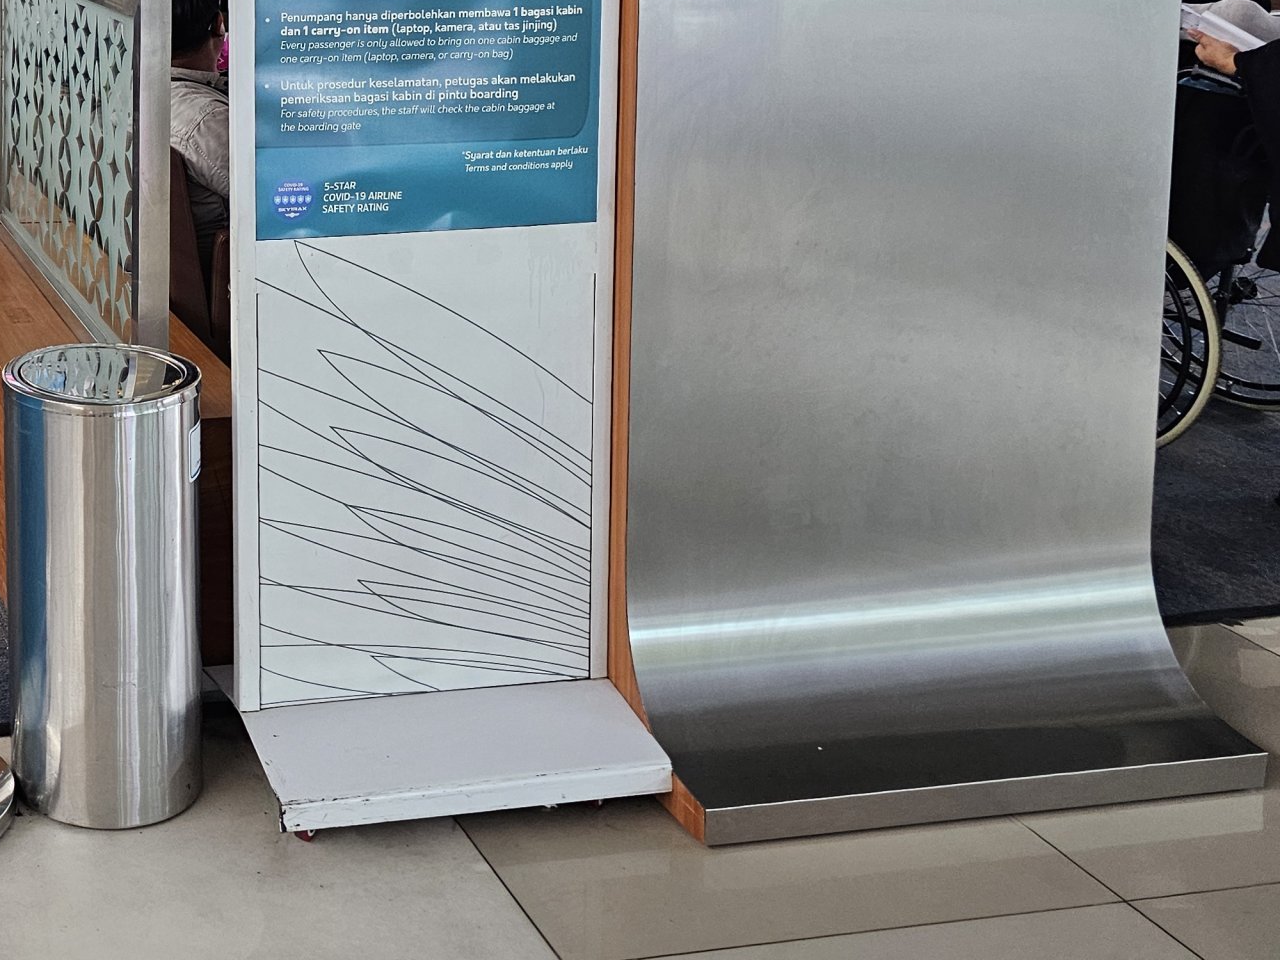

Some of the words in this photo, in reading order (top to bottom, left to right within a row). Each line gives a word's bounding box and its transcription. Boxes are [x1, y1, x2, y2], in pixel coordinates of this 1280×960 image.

[281, 12, 343, 24] Penumpang
[345, 11, 378, 23] hanya
[381, 8, 456, 23] diperbolehkan
[458, 7, 511, 18] membawa
[513, 7, 518, 17] 1
[521, 5, 554, 18] bagasi
[556, 4, 583, 16] kabin
[281, 26, 301, 36] dan
[303, 26, 309, 36] 1
[311, 24, 361, 37] carry-on
[363, 24, 389, 34] item
[392, 22, 433, 36] (laptop,
[435, 21, 476, 33] kamera,
[478, 21, 502, 31] atau
[504, 21, 520, 30] tas
[521, 18, 557, 33] jinjing)
[280, 41, 306, 51] Every
[308, 39, 355, 51] passenger
[357, 39, 365, 48] is
[367, 38, 387, 49] only
[389, 37, 425, 47] allowed
[427, 38, 436, 46] to
[437, 36, 462, 47] bring
[477, 37, 496, 45] one
[497, 35, 521, 44] cabin
[523, 33, 560, 45] baggage
[561, 32, 578, 42] and
[280, 80, 314, 90] Untuk
[317, 78, 367, 91] prosedur
[369, 77, 442, 88] keselamatan,
[444, 76, 489, 89] petugas
[491, 74, 518, 85] akan
[520, 72, 576, 84] melakukan
[280, 93, 351, 107] pemeriksaan
[353, 91, 389, 104] bagasi
[392, 90, 422, 101] kabin
[425, 90, 435, 100] di
[438, 89, 467, 102] pintu
[470, 88, 519, 101] boarding
[495, 150, 512, 158] dan
[513, 148, 556, 158] ketentuan
[557, 146, 589, 156] berlaku
[465, 164, 490, 172] Terms
[491, 163, 507, 171] and
[508, 161, 549, 170] conditions
[550, 159, 574, 169] apply
[324, 181, 357, 192] 5-STAR
[323, 192, 366, 202] COVID-19
[368, 191, 403, 200] AIRLINE
[322, 204, 354, 214] SAFETY
[357, 202, 390, 213] RATING
